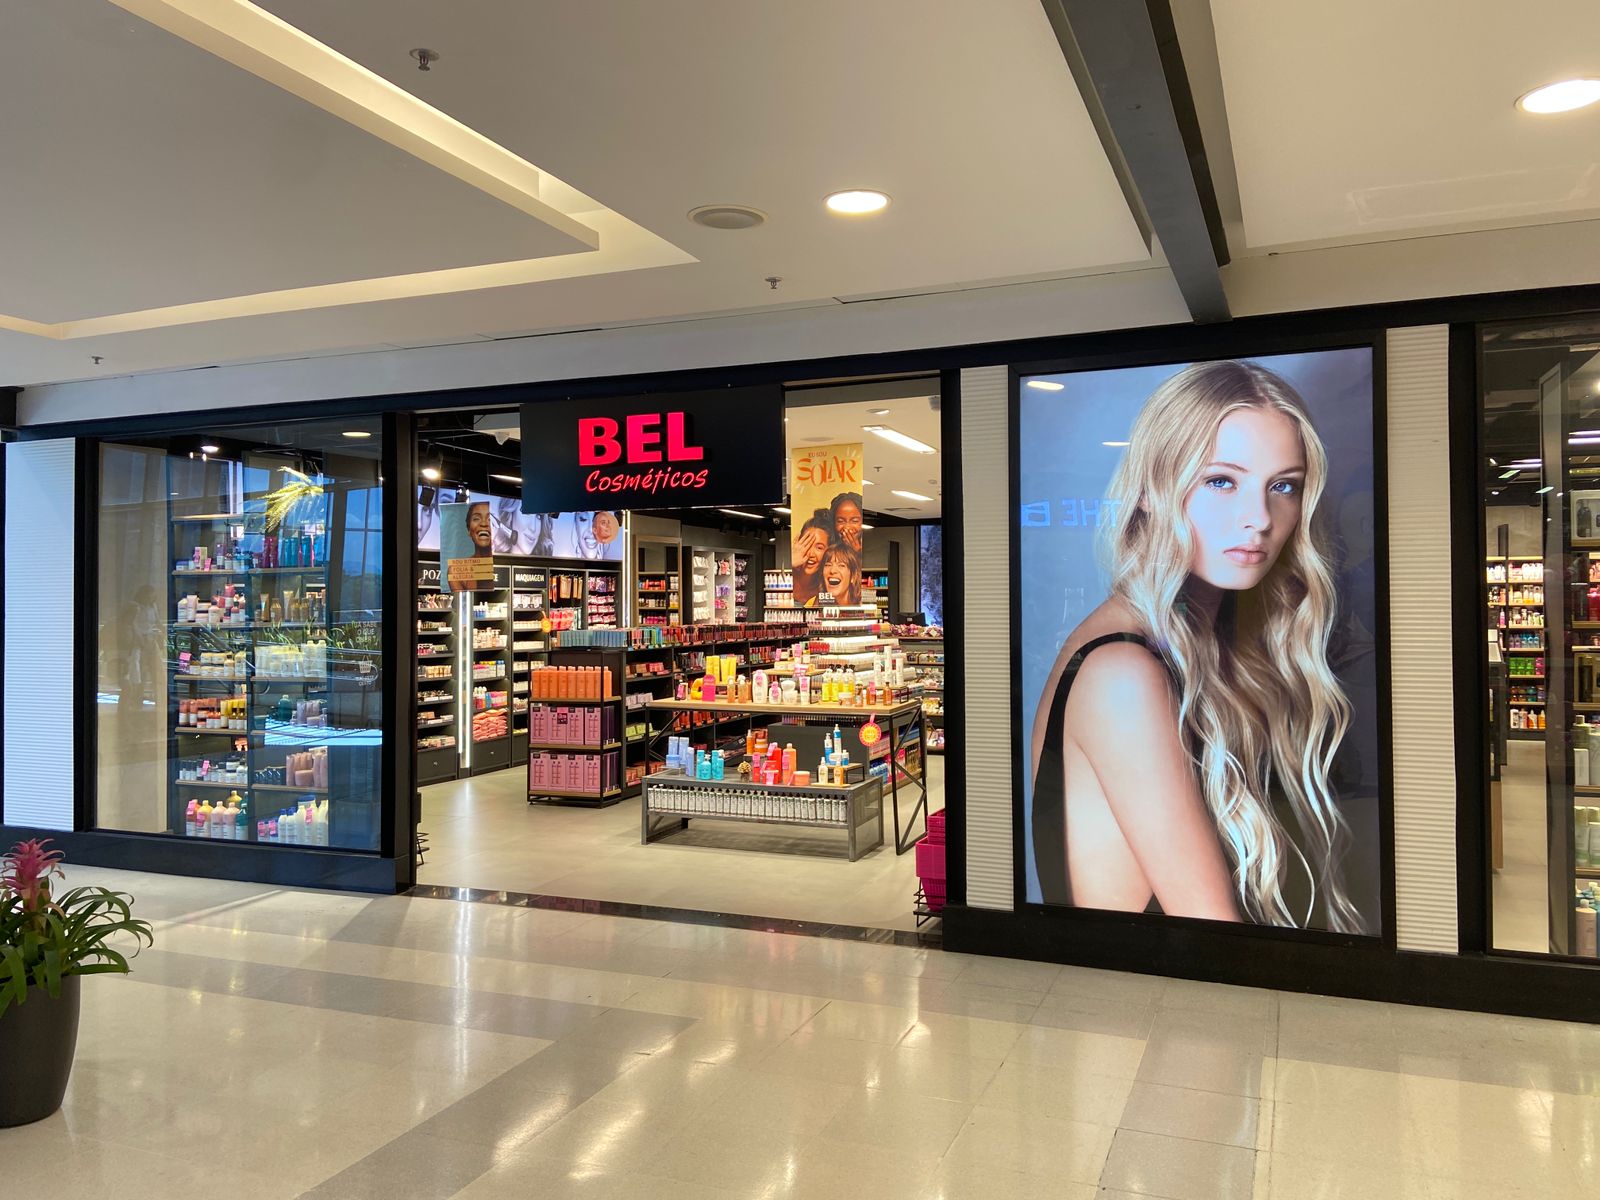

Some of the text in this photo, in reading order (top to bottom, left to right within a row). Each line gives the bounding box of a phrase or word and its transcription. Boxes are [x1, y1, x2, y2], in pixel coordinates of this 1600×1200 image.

[578, 411, 704, 466] BEL
[585, 466, 709, 494] Cosméticos
[797, 456, 856, 486] SOLAR
[423, 569, 441, 580] POZ
[515, 573, 545, 582] MAQUIAGEM
[818, 592, 836, 600] BEL
